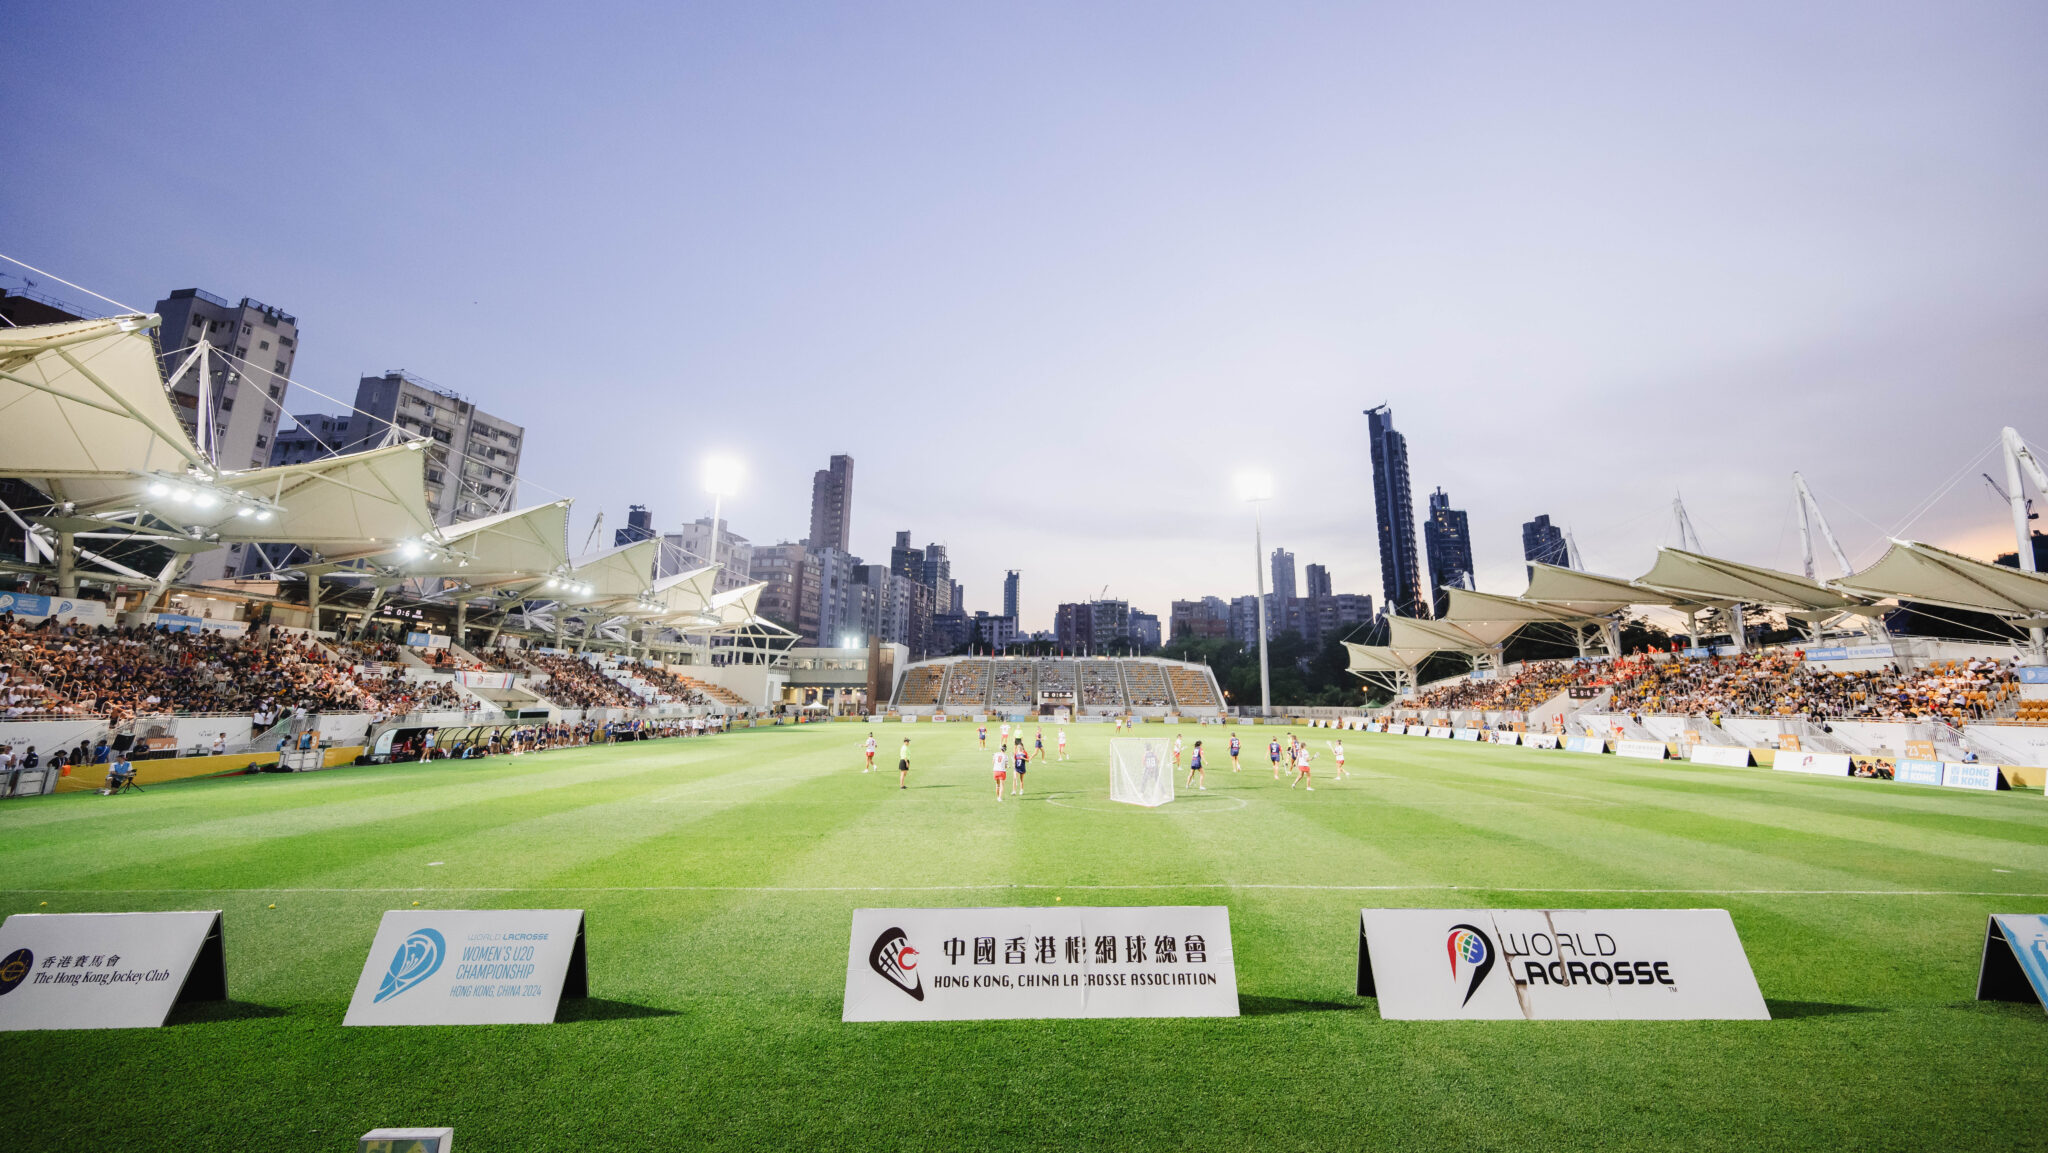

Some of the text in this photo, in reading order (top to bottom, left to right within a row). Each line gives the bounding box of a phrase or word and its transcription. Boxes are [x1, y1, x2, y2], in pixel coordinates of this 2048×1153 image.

[1961, 767, 1989, 777] HONG
[1960, 776, 1988, 787] KONG
[502, 933, 549, 941] LACROSSE
[1499, 933, 1616, 956] WORLD
[462, 946, 535, 961] WOMEN'S U20
[41, 954, 121, 969] 香港賽馬會
[33, 969, 170, 986] The Hong Kong Jockey Club
[456, 964, 535, 980] CHAMPIONSHIP
[934, 975, 969, 988] HONG
[973, 975, 1013, 989] KONG,
[1018, 974, 1059, 987] CHINA
[1130, 972, 1216, 986] ASSOCIATION
[449, 985, 472, 998] HONG
[496, 985, 521, 997] CHINA
[521, 985, 542, 997] 2024
